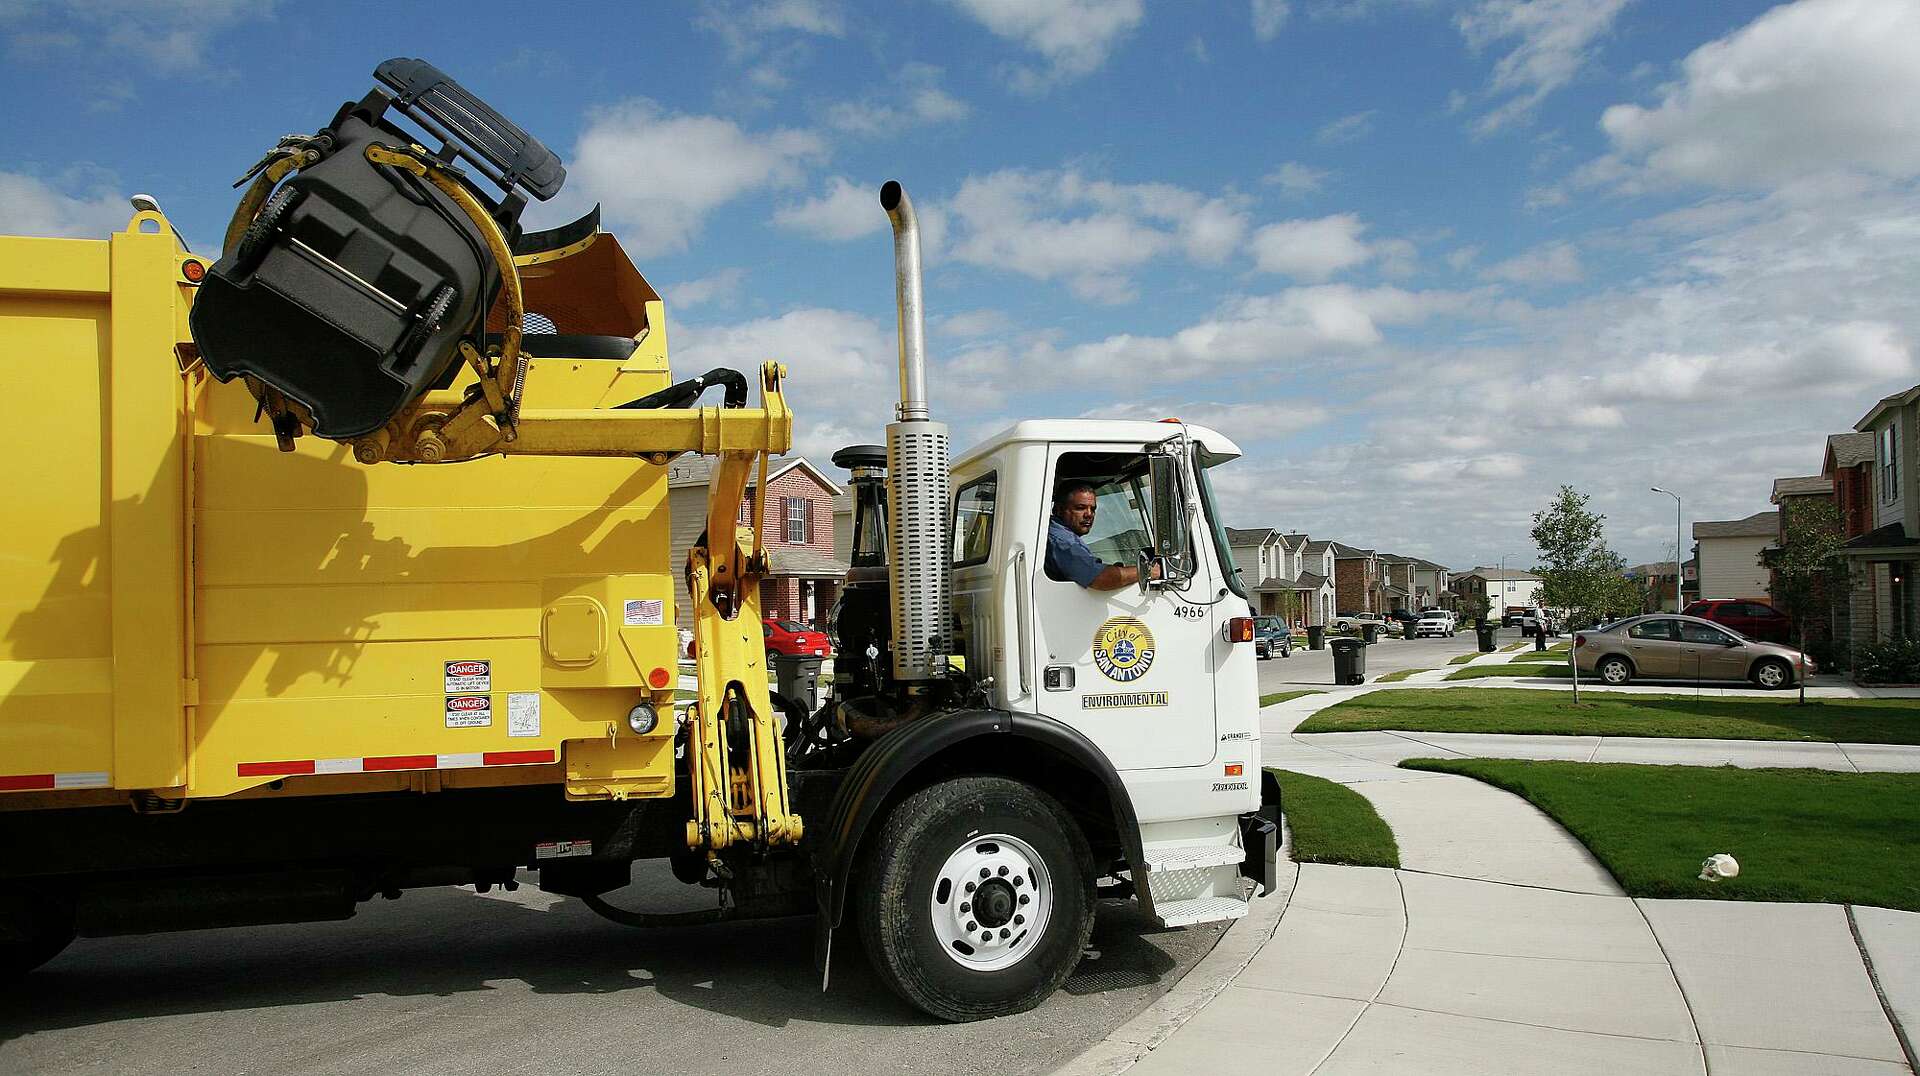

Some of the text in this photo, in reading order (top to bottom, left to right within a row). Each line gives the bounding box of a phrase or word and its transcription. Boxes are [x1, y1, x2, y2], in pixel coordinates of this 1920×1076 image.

[1173, 606, 1204, 618] 4966
[1106, 628, 1141, 643] City of
[450, 665, 485, 673] DANGER
[1095, 650, 1154, 681] SAN ANTONIO
[451, 700, 486, 708] DANGER
[1083, 693, 1167, 708] ENVIRONMENTAL
